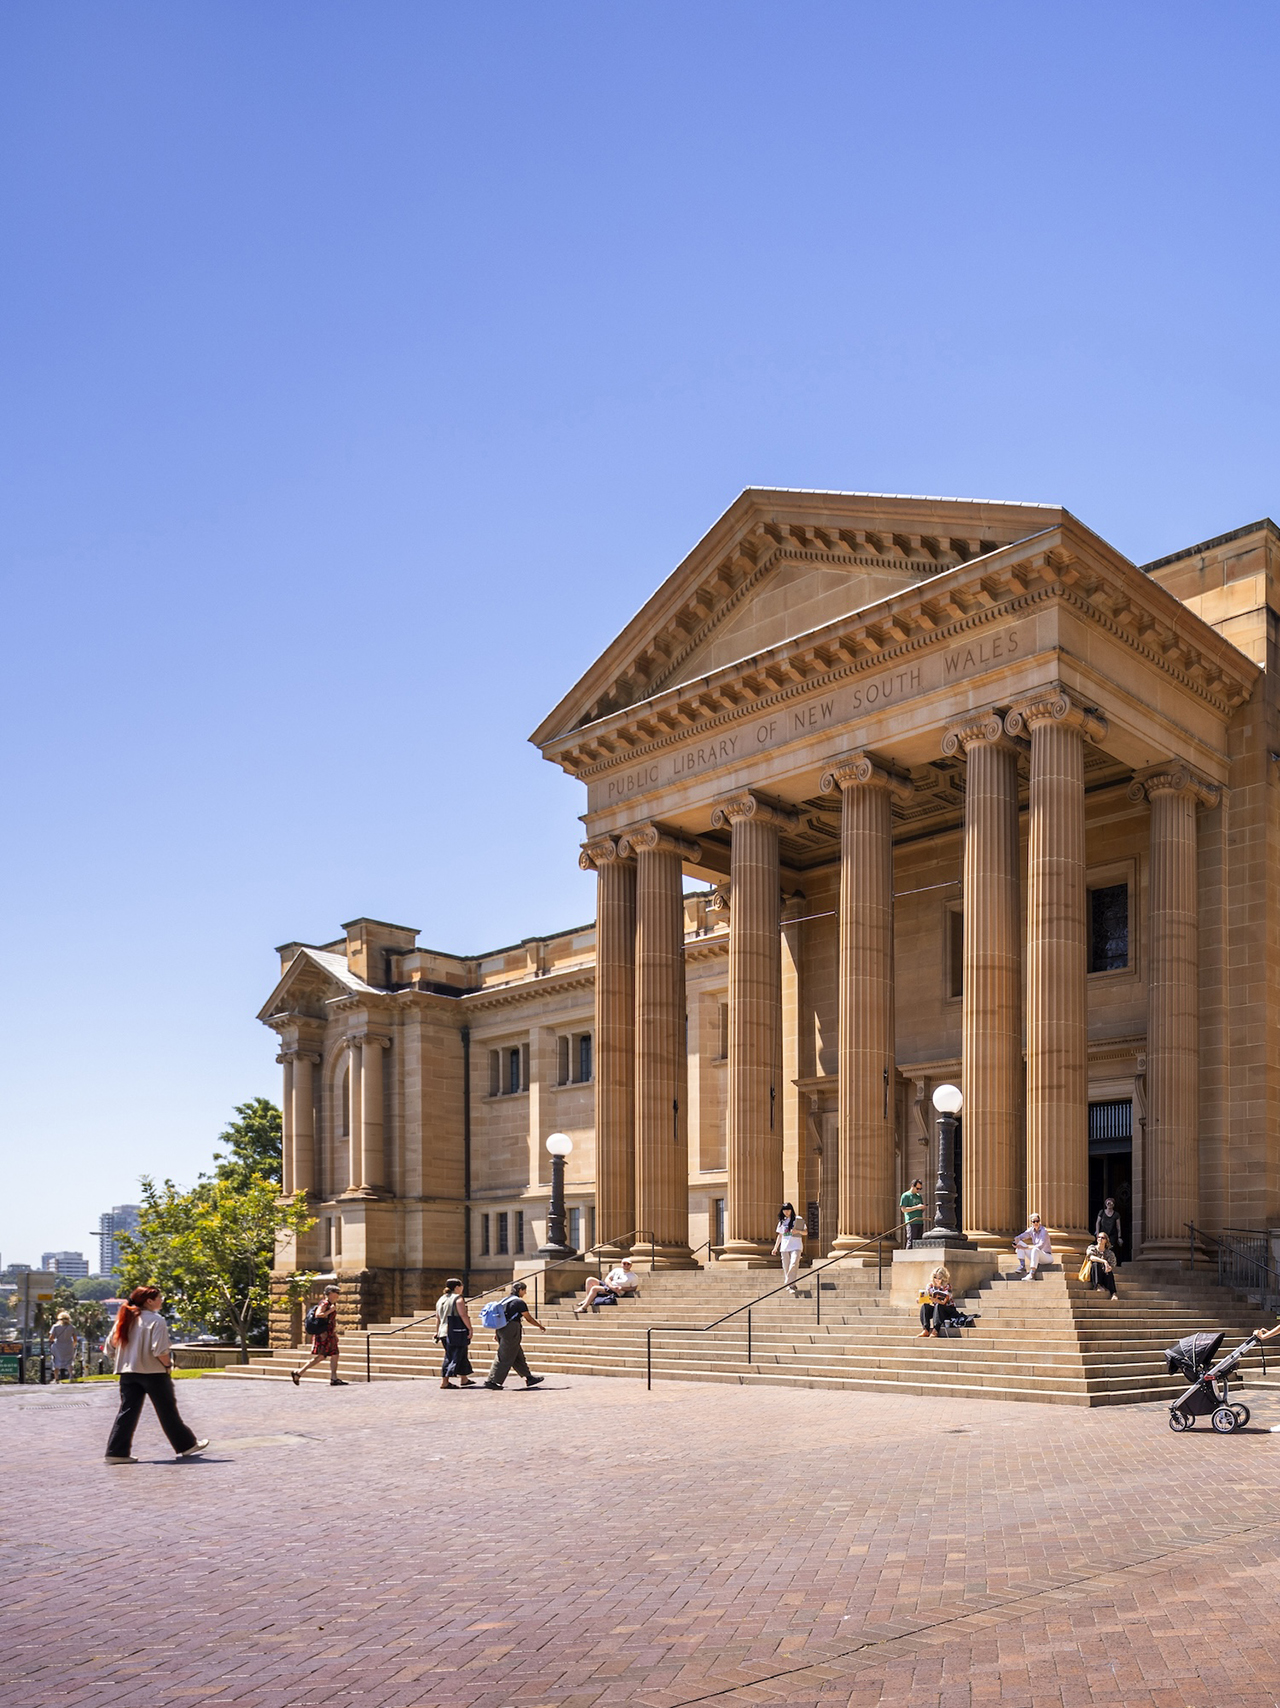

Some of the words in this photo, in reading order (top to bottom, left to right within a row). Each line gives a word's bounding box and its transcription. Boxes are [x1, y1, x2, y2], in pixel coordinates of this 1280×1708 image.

[608, 765, 659, 798] PUBLIC
[673, 735, 738, 775] LIBRARY
[756, 721, 777, 744] OF
[794, 700, 834, 731] NEW
[853, 667, 921, 710] SOUTH
[944, 631, 1019, 675] WALES
